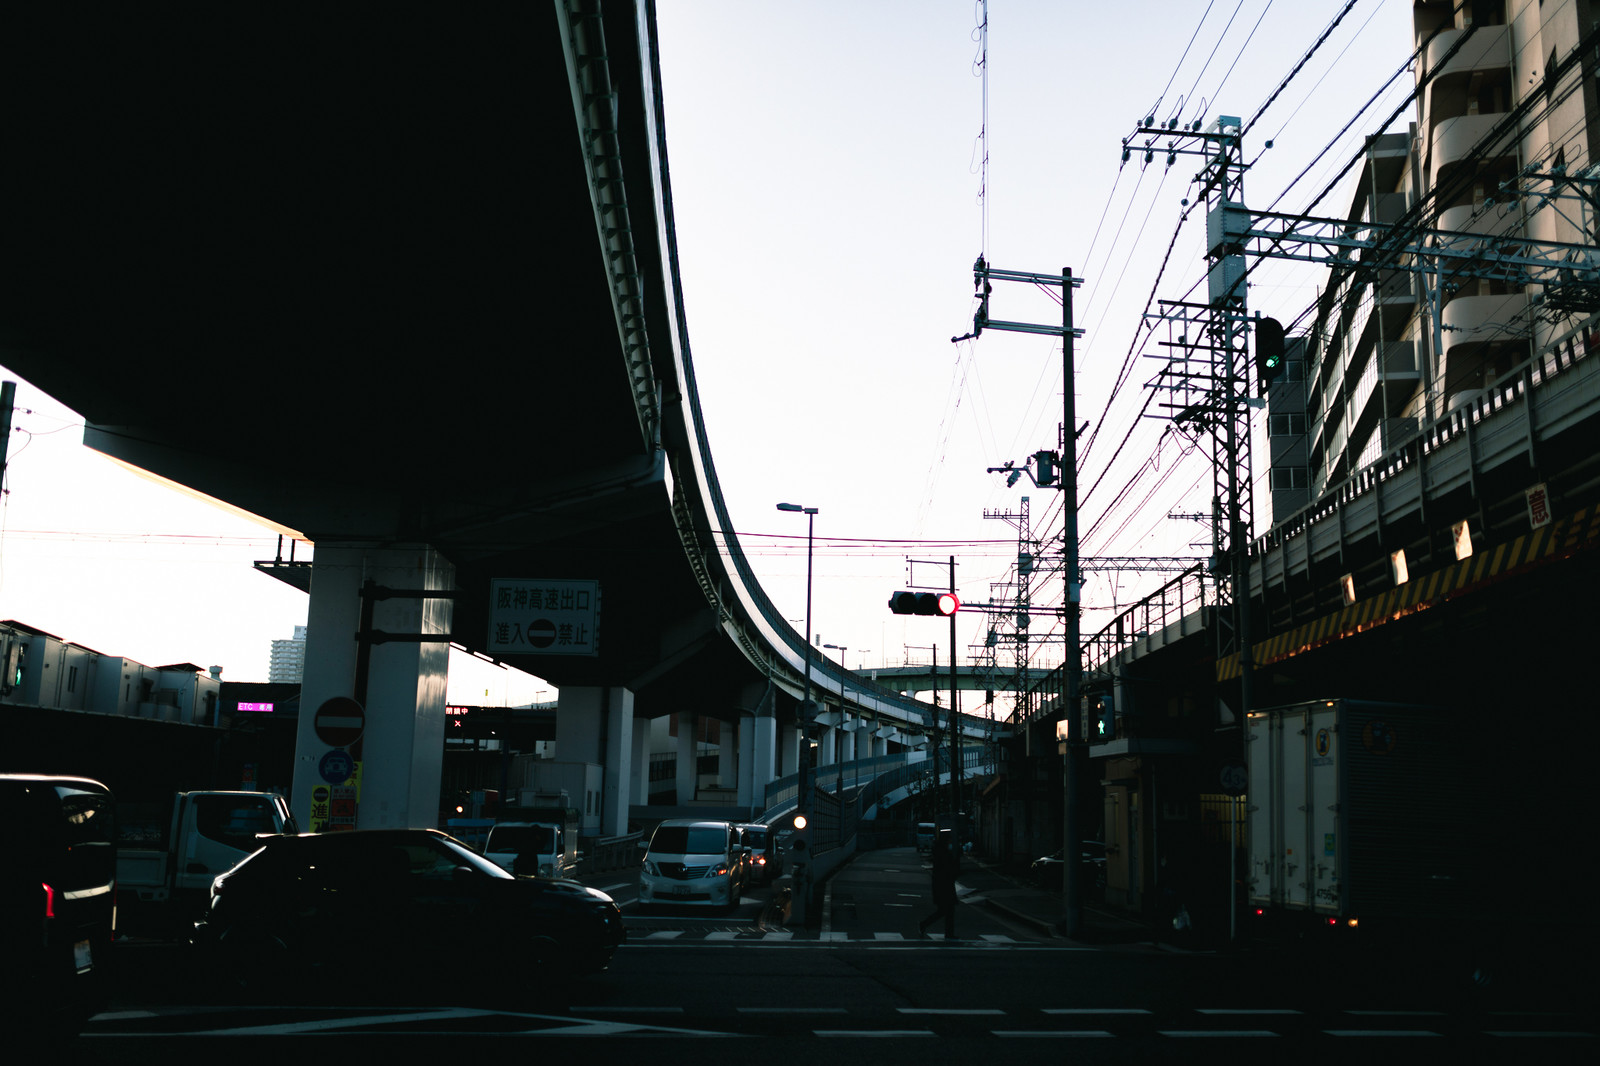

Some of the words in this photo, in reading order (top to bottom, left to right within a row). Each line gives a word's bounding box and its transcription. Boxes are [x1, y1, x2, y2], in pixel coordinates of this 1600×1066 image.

[1529, 489, 1549, 524] 意
[497, 587, 590, 610] 阪神高速出口
[495, 623, 525, 644] 進入
[558, 624, 588, 646] 禁止
[238, 702, 253, 711] ETC
